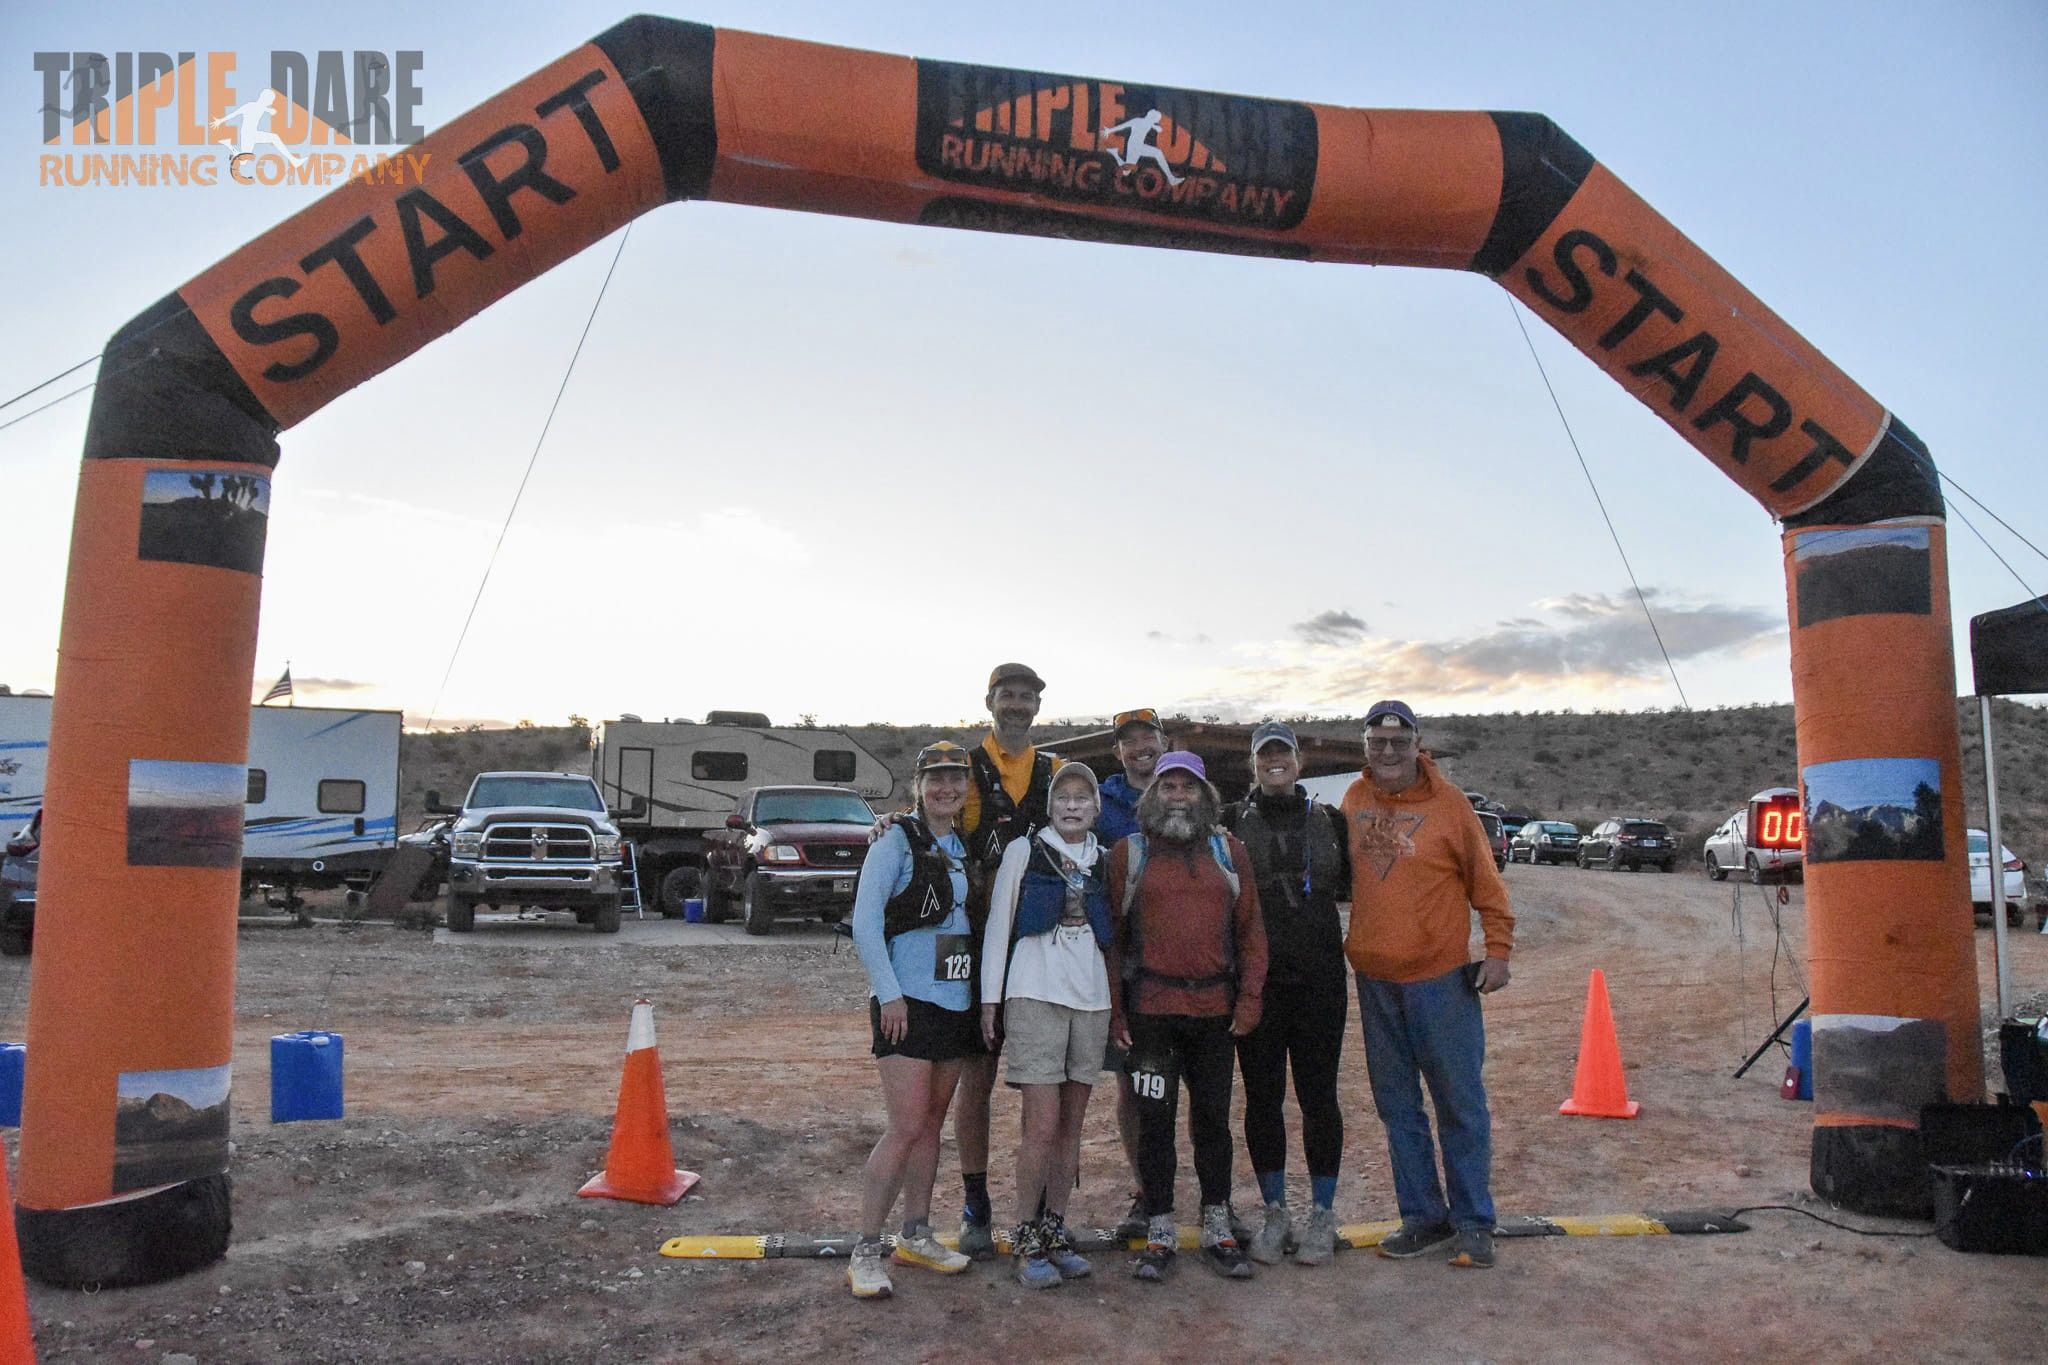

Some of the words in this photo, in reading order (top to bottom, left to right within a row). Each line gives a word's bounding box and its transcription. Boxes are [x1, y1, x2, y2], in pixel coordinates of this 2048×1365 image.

[941, 132, 1102, 189] RUNNING
[1114, 164, 1293, 216] COMPANY
[230, 67, 620, 382] START
[1525, 229, 1856, 492] START
[945, 954, 971, 979] 123
[1131, 1070, 1165, 1100] 119
